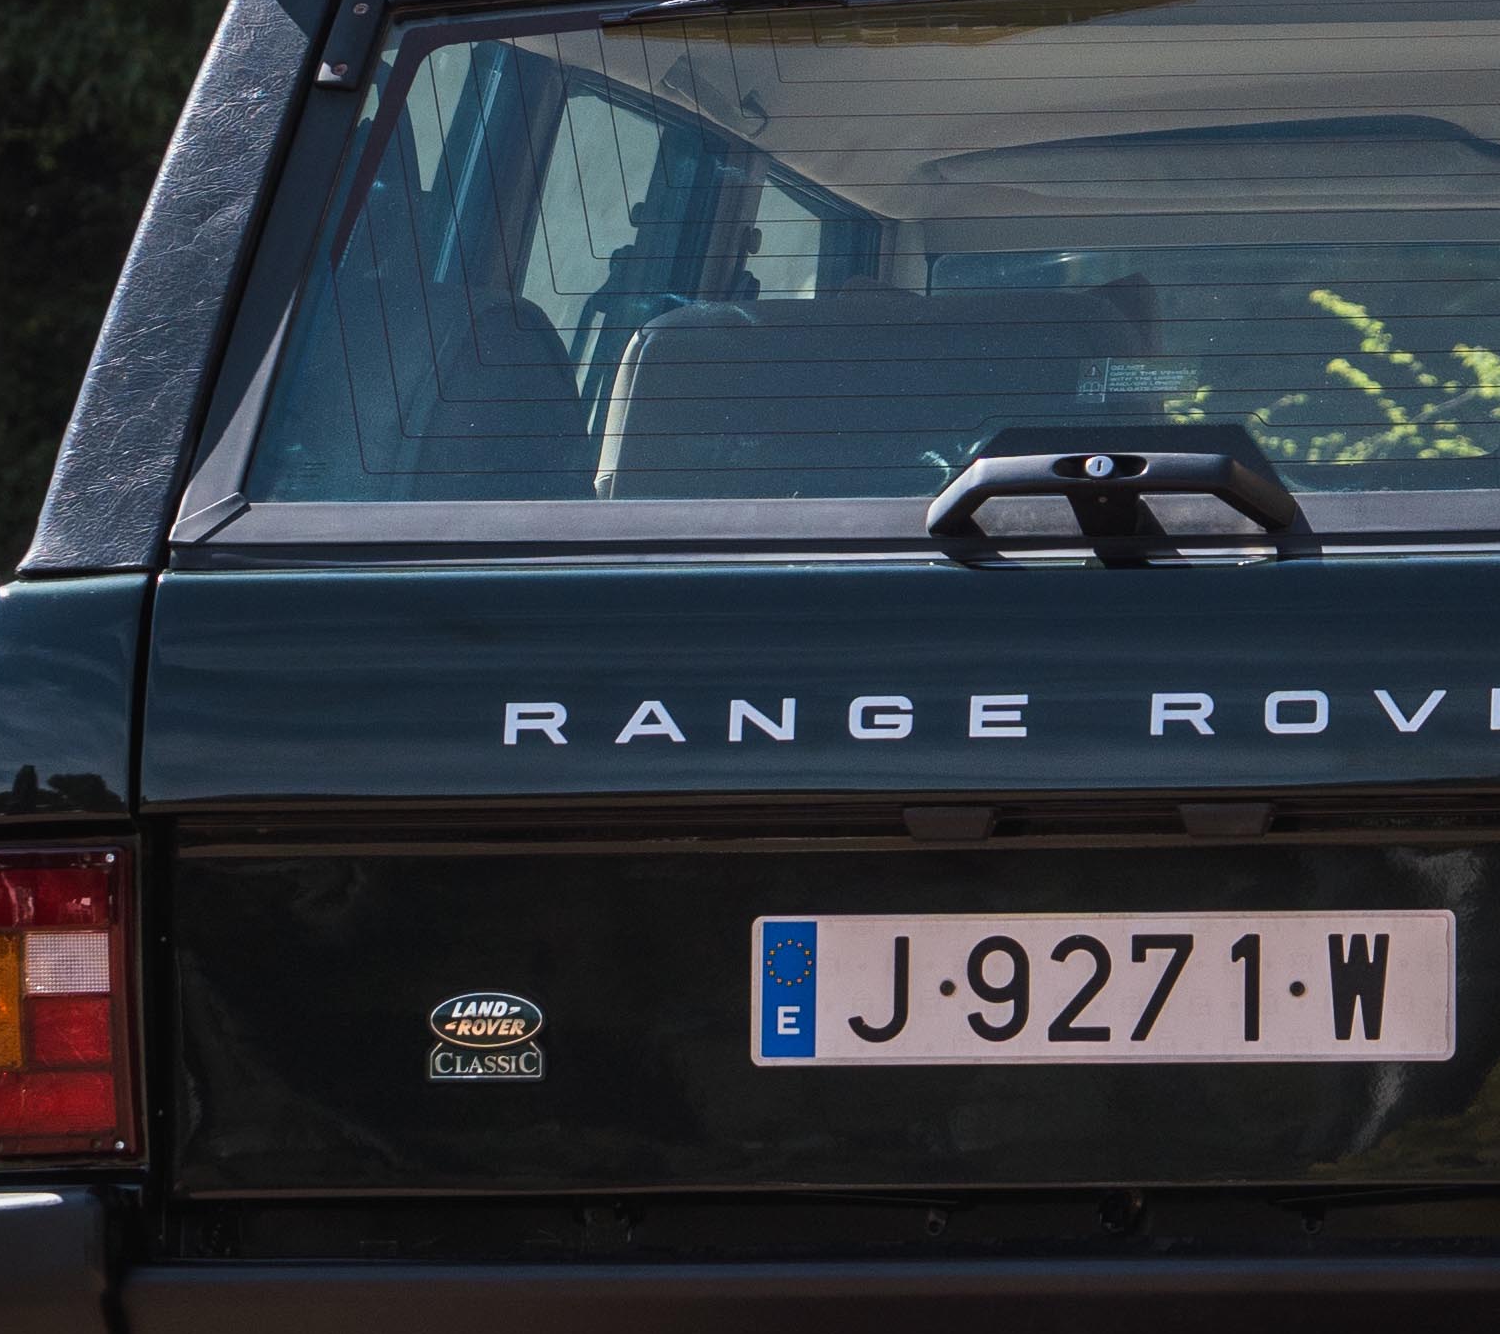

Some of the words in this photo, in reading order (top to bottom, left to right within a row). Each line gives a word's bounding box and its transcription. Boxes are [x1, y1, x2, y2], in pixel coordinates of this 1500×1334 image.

[502, 693, 1029, 746] RANGE
[451, 1001, 509, 1018] LAND
[777, 1005, 801, 1034] E
[456, 1018, 526, 1036] ROVER
[434, 1051, 538, 1074] CLASSIC
